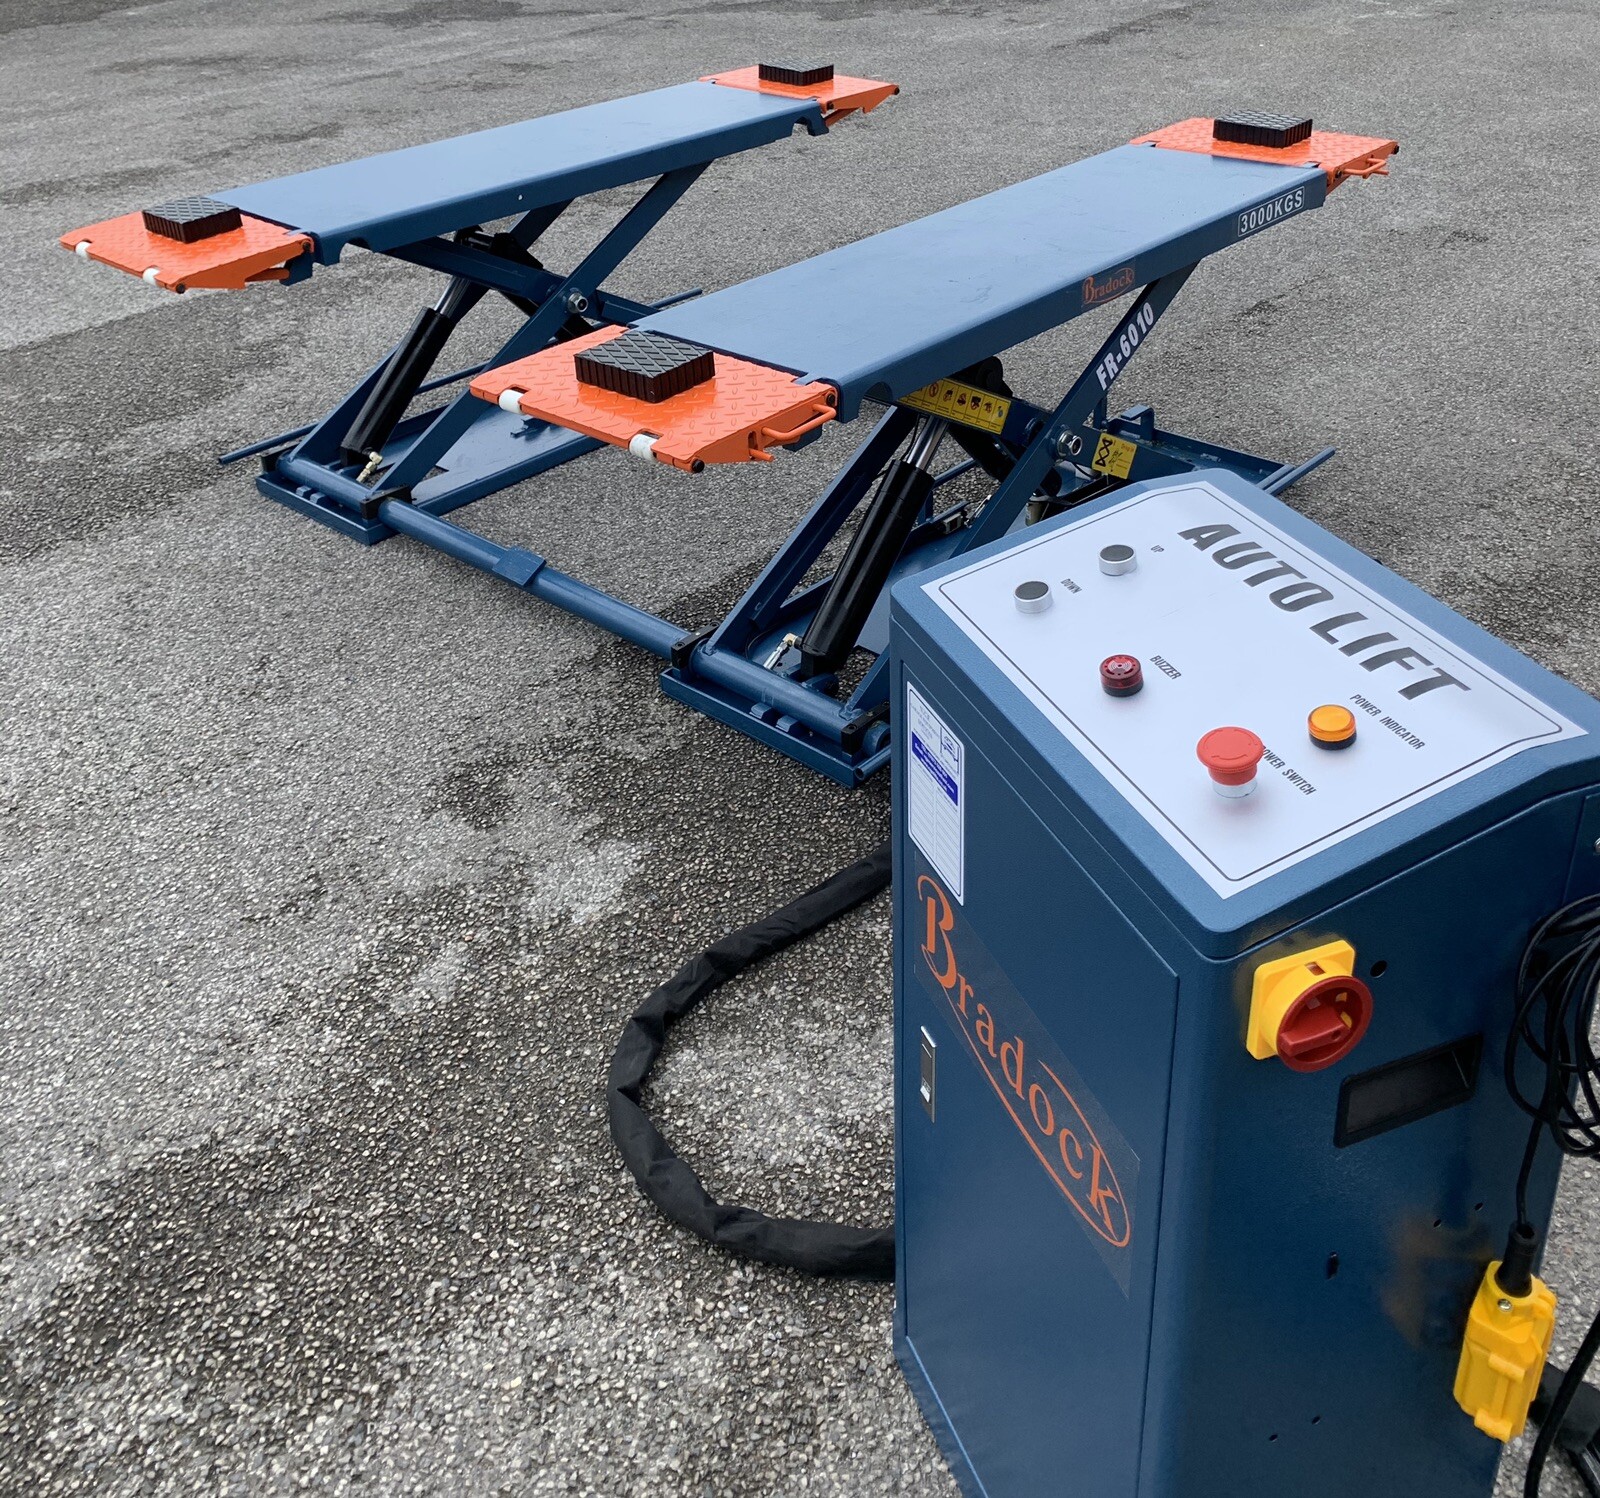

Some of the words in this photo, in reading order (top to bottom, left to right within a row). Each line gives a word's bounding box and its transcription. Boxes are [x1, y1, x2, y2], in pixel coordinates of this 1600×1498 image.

[1241, 190, 1303, 233] 3000KGS
[1082, 267, 1135, 305] Bradock
[1095, 302, 1154, 391] FR-6010
[1150, 544, 1165, 553] UP
[1060, 578, 1082, 594] DOWN
[1177, 523, 1335, 612] AUTO
[1309, 611, 1472, 700] LIFT
[1149, 655, 1182, 680] BUZZER
[1349, 693, 1382, 717] POWER
[1379, 716, 1426, 750] INDICATOR
[1262, 745, 1286, 769] OWER
[1281, 768, 1317, 796] SWITCH
[917, 875, 1130, 1247] Bradock
